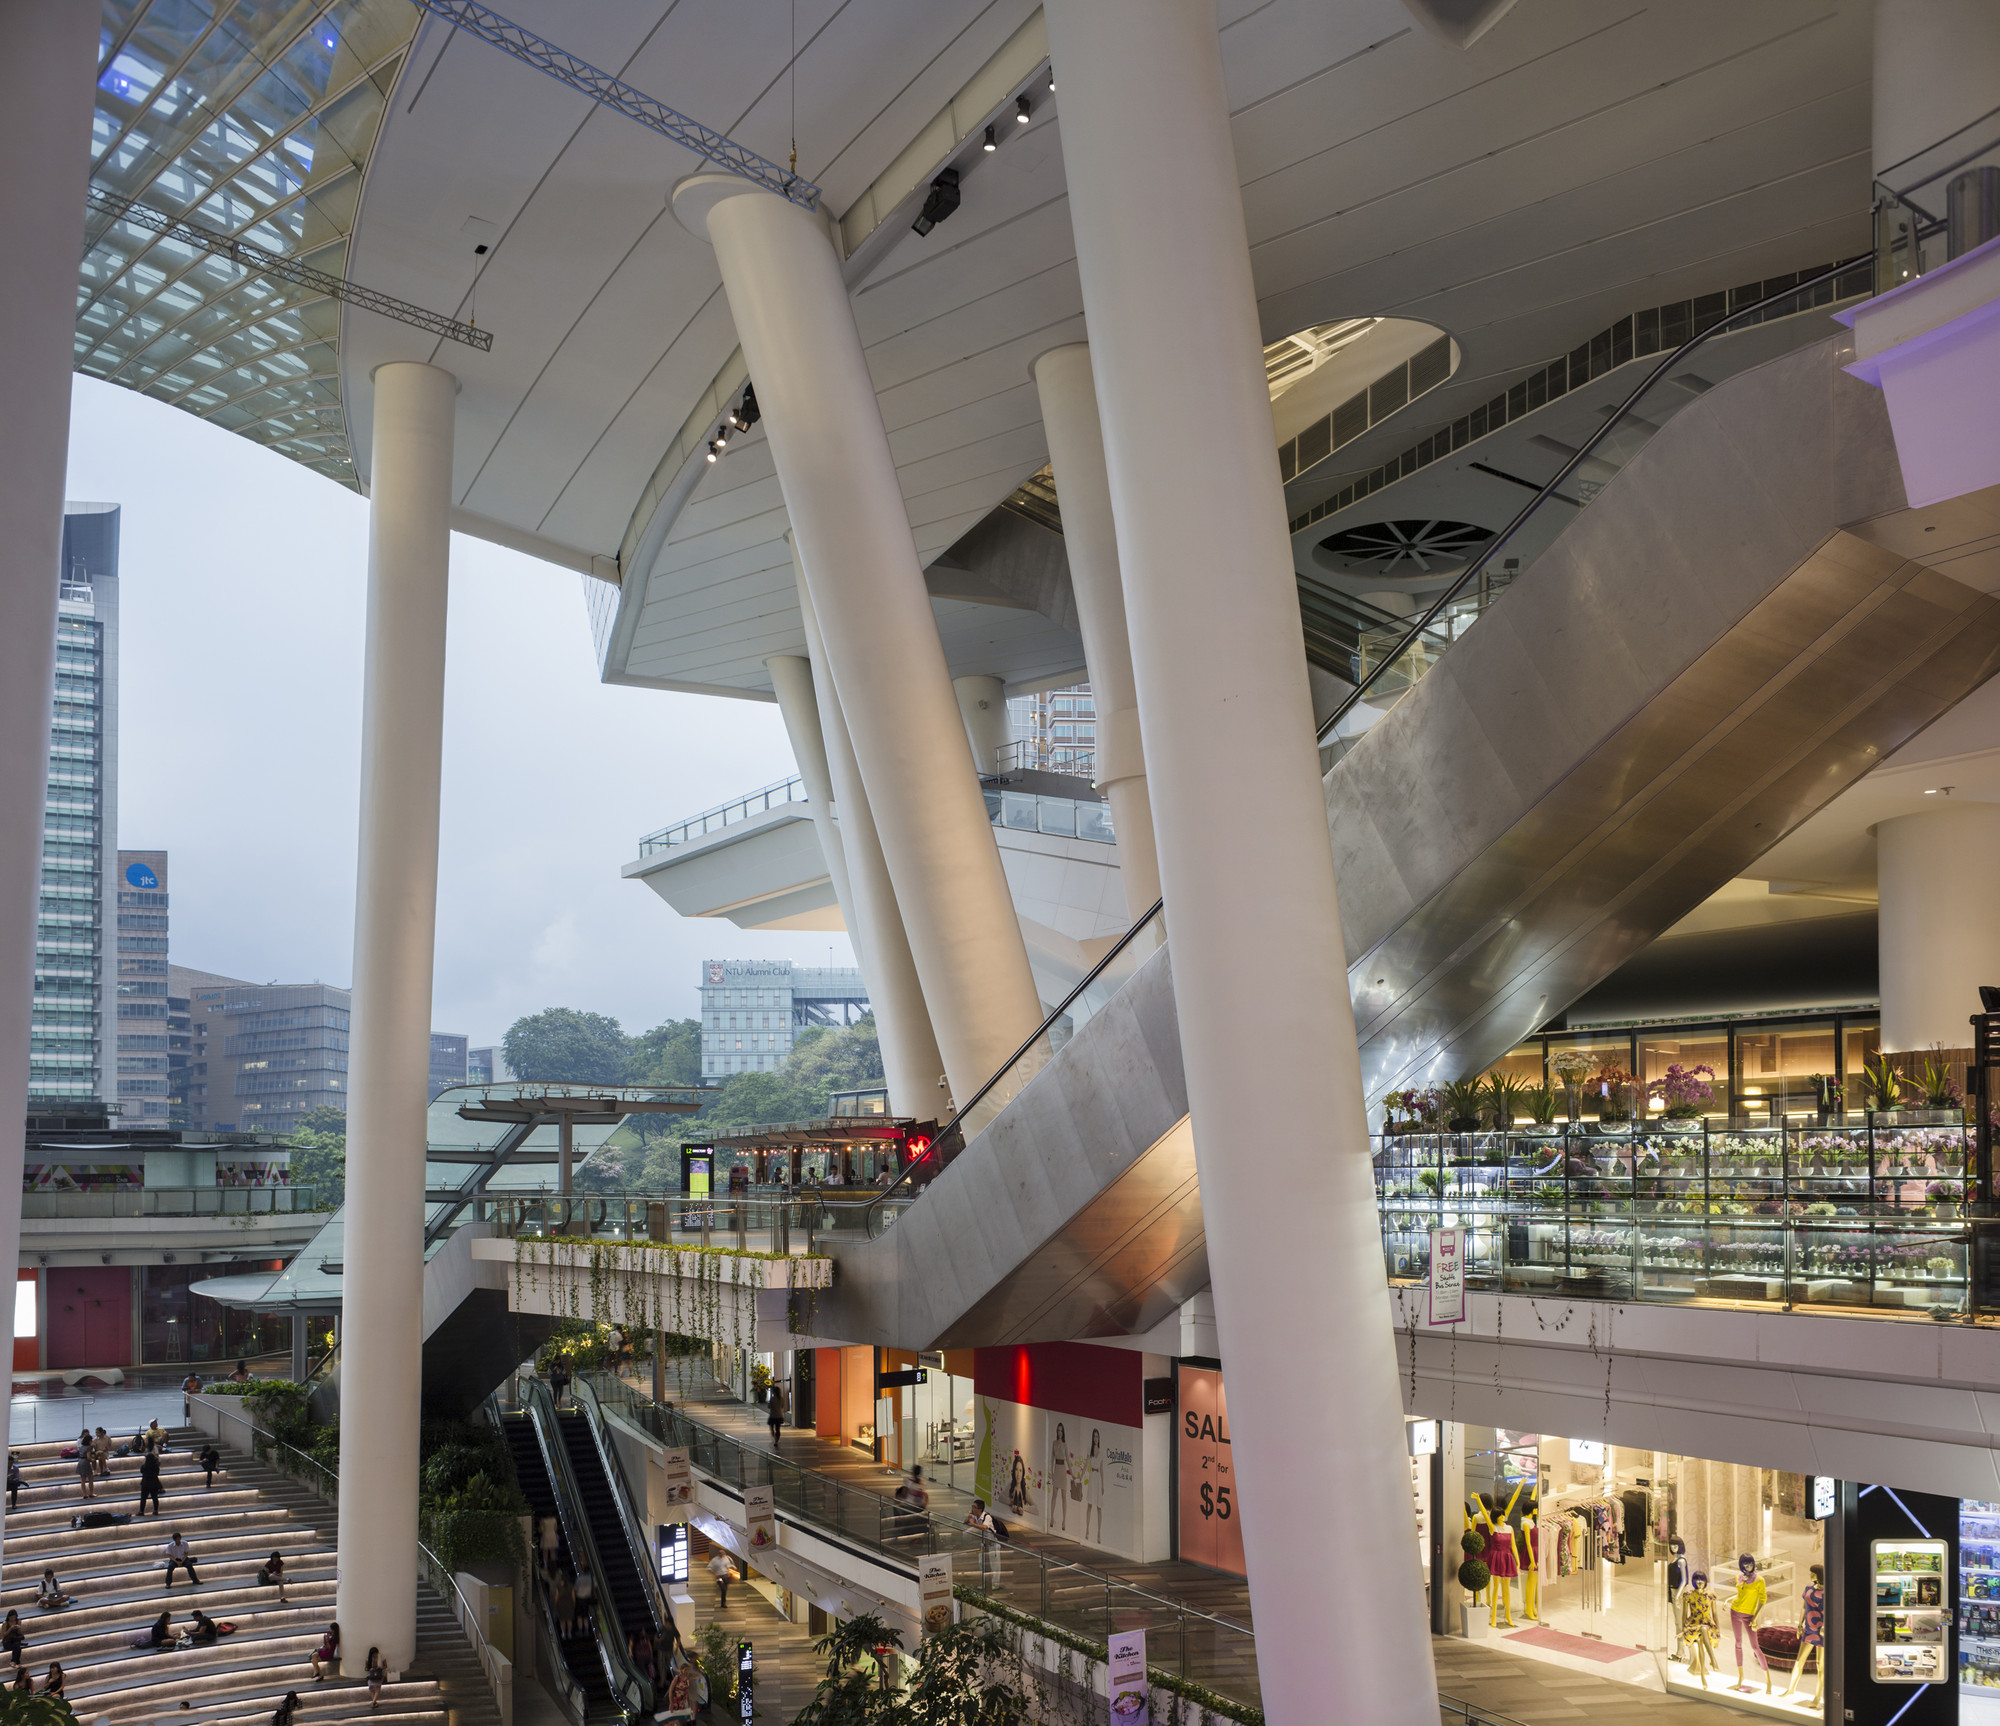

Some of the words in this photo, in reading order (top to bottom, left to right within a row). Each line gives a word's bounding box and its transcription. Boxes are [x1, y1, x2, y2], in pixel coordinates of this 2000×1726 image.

[140, 876, 155, 886] jtc
[725, 968, 743, 976] NTU
[745, 967, 772, 976] Alumni
[772, 967, 790, 976] Club
[1436, 1261, 1460, 1273] FREE
[1217, 1462, 1229, 1474] for
[1200, 1481, 1231, 1520] $5
[1114, 1651, 1139, 1660] Kitchen
